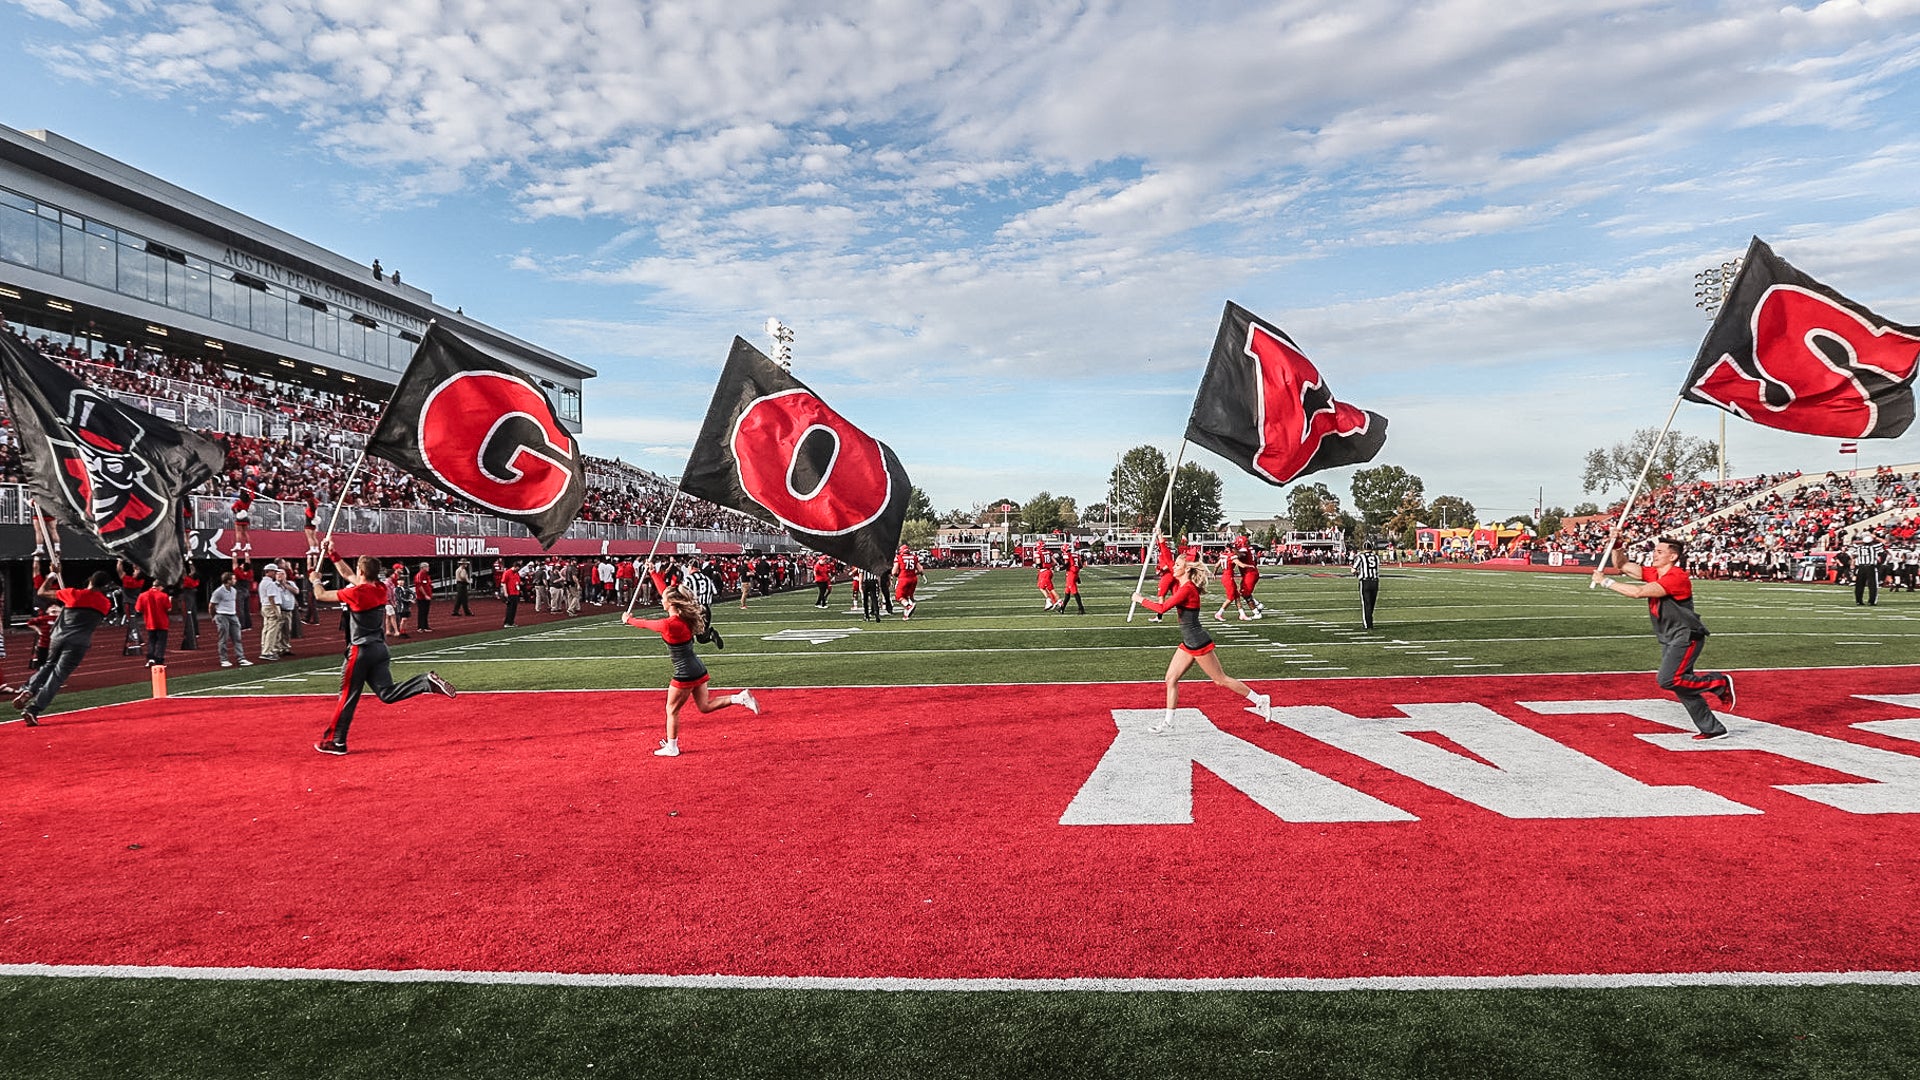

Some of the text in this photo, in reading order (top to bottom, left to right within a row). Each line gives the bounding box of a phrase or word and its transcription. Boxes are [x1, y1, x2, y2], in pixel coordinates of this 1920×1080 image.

[223, 246, 281, 281] AUSTIN
[287, 270, 321, 296] PEAY
[325, 284, 364, 311] STATE
[417, 369, 573, 516] G
[730, 388, 892, 536] O
[435, 536, 456, 556] LET'S
[456, 538, 468, 556] GO
[903, 559, 915, 570] 75
[1367, 556, 1376, 568] S
[698, 579, 707, 594] B
[1059, 693, 1920, 825] EAY
